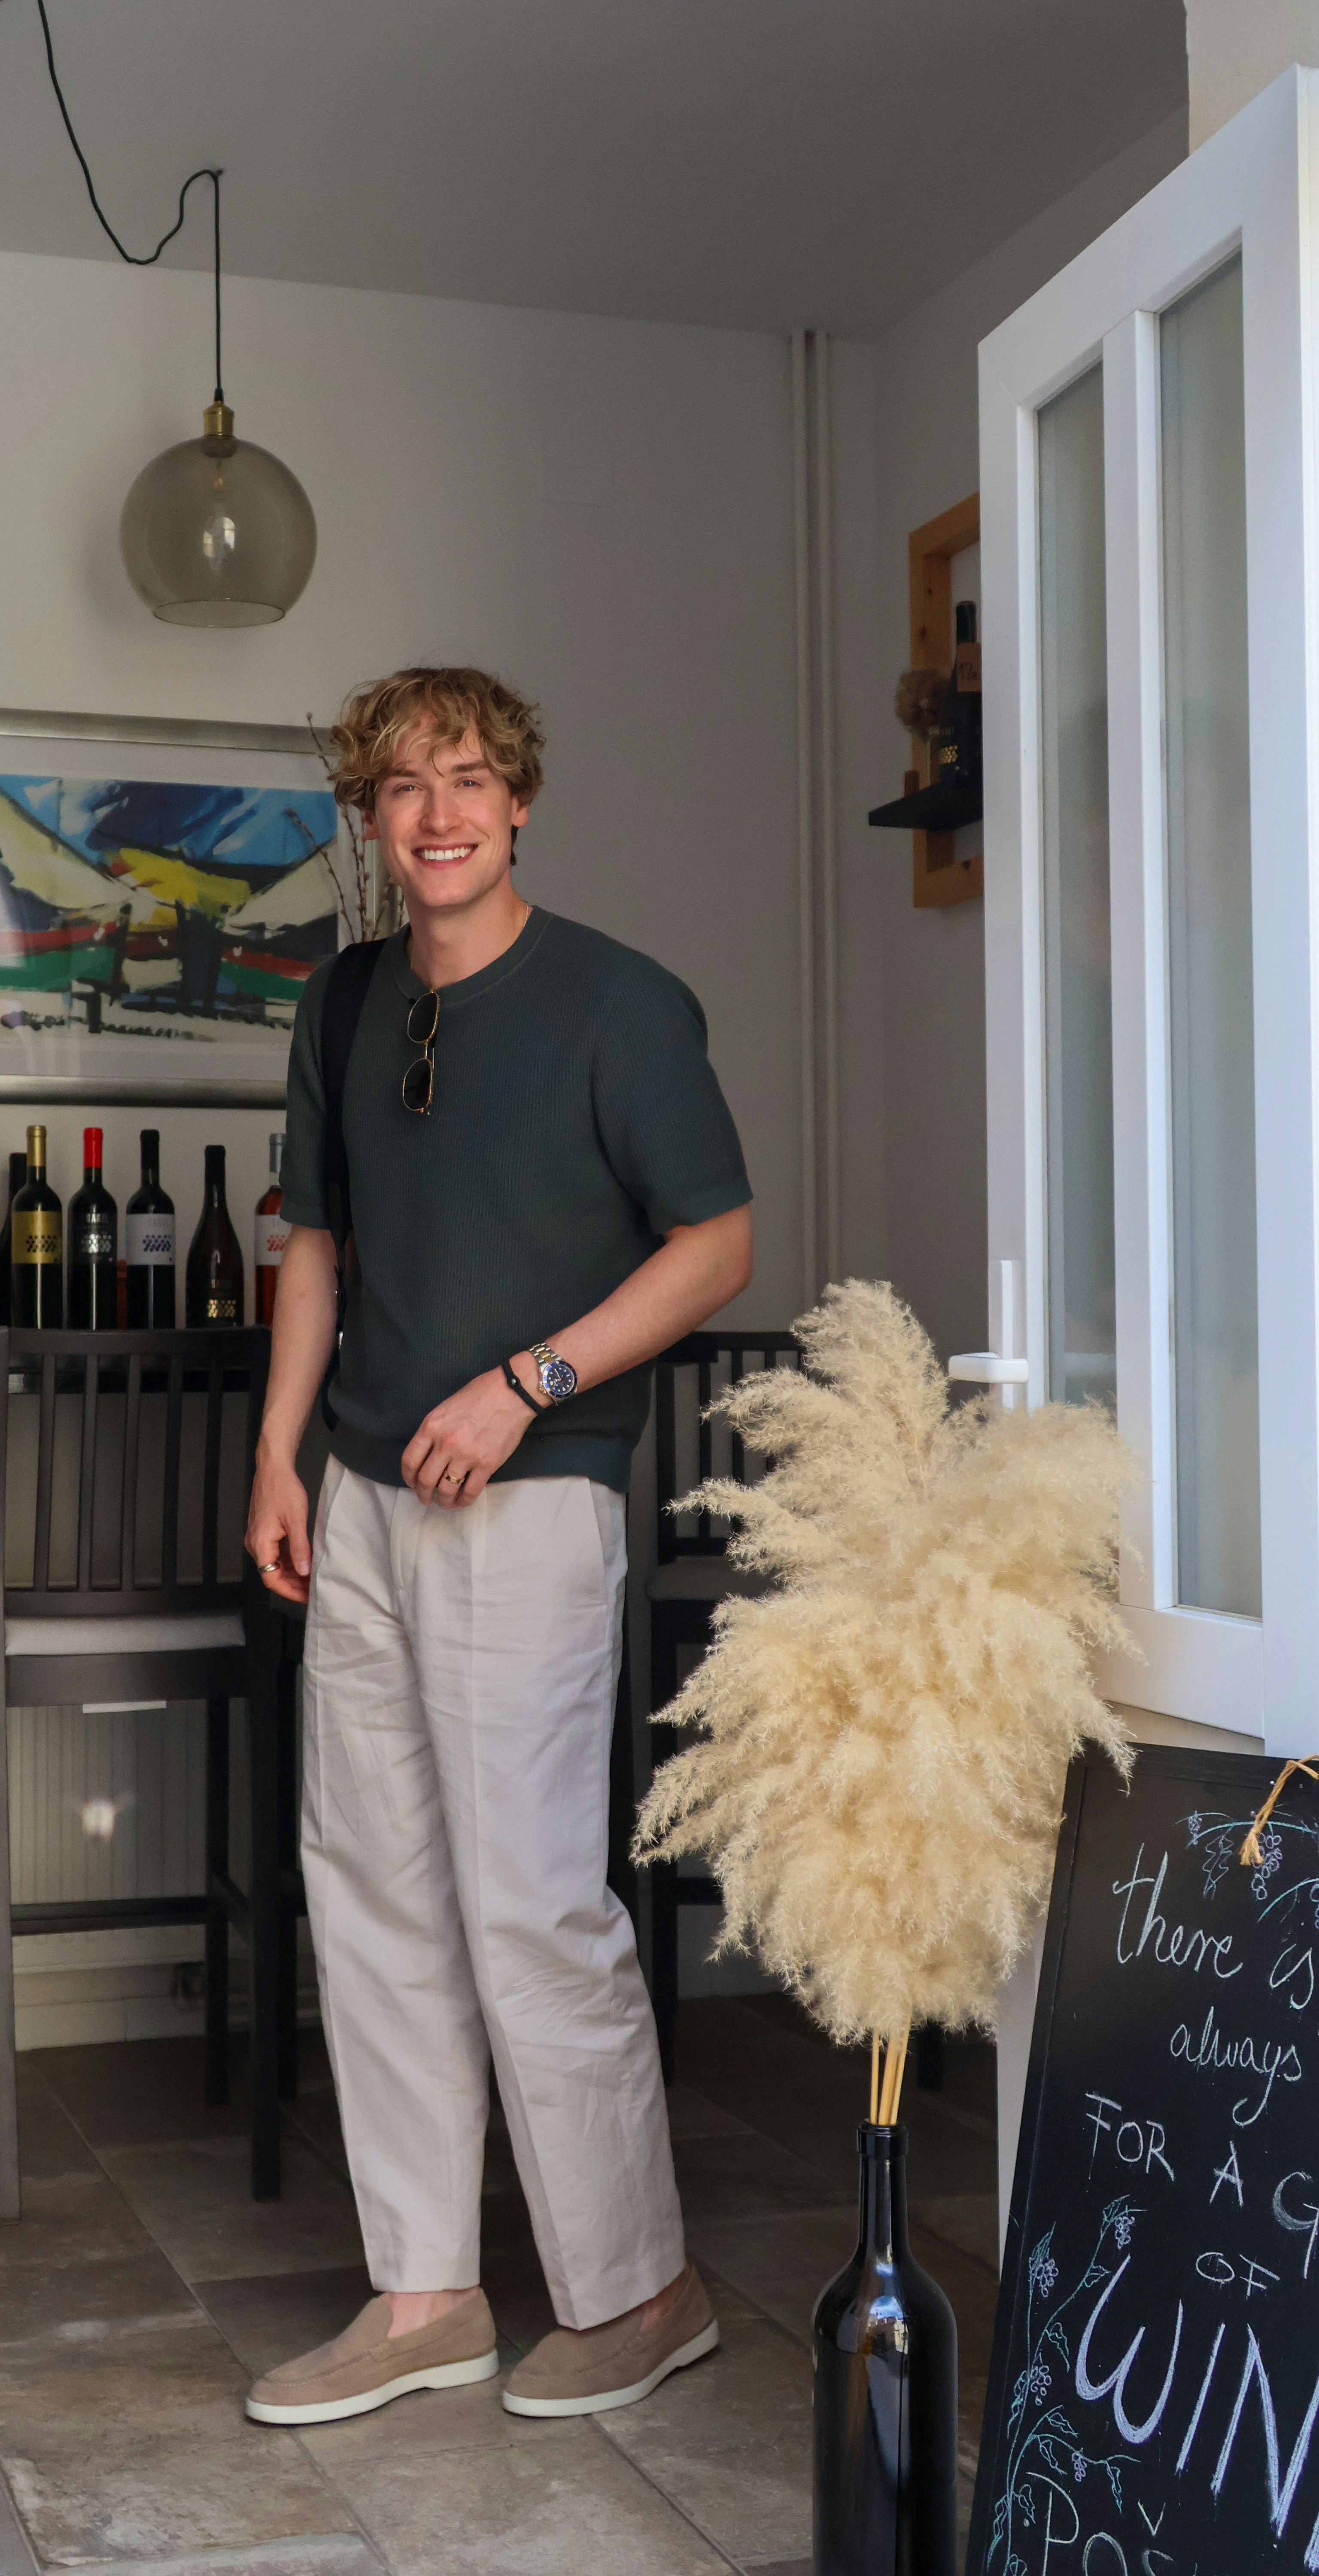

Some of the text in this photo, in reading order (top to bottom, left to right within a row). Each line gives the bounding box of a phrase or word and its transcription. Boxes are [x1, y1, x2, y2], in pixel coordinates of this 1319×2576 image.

[1112, 1843, 1243, 1979] there
[1170, 2006, 1302, 2127] always
[1085, 2092, 1175, 2182] FOR
[1209, 2141, 1244, 2208] A
[1195, 2252, 1280, 2300] OF
[1076, 2254, 1319, 2573] WIN
